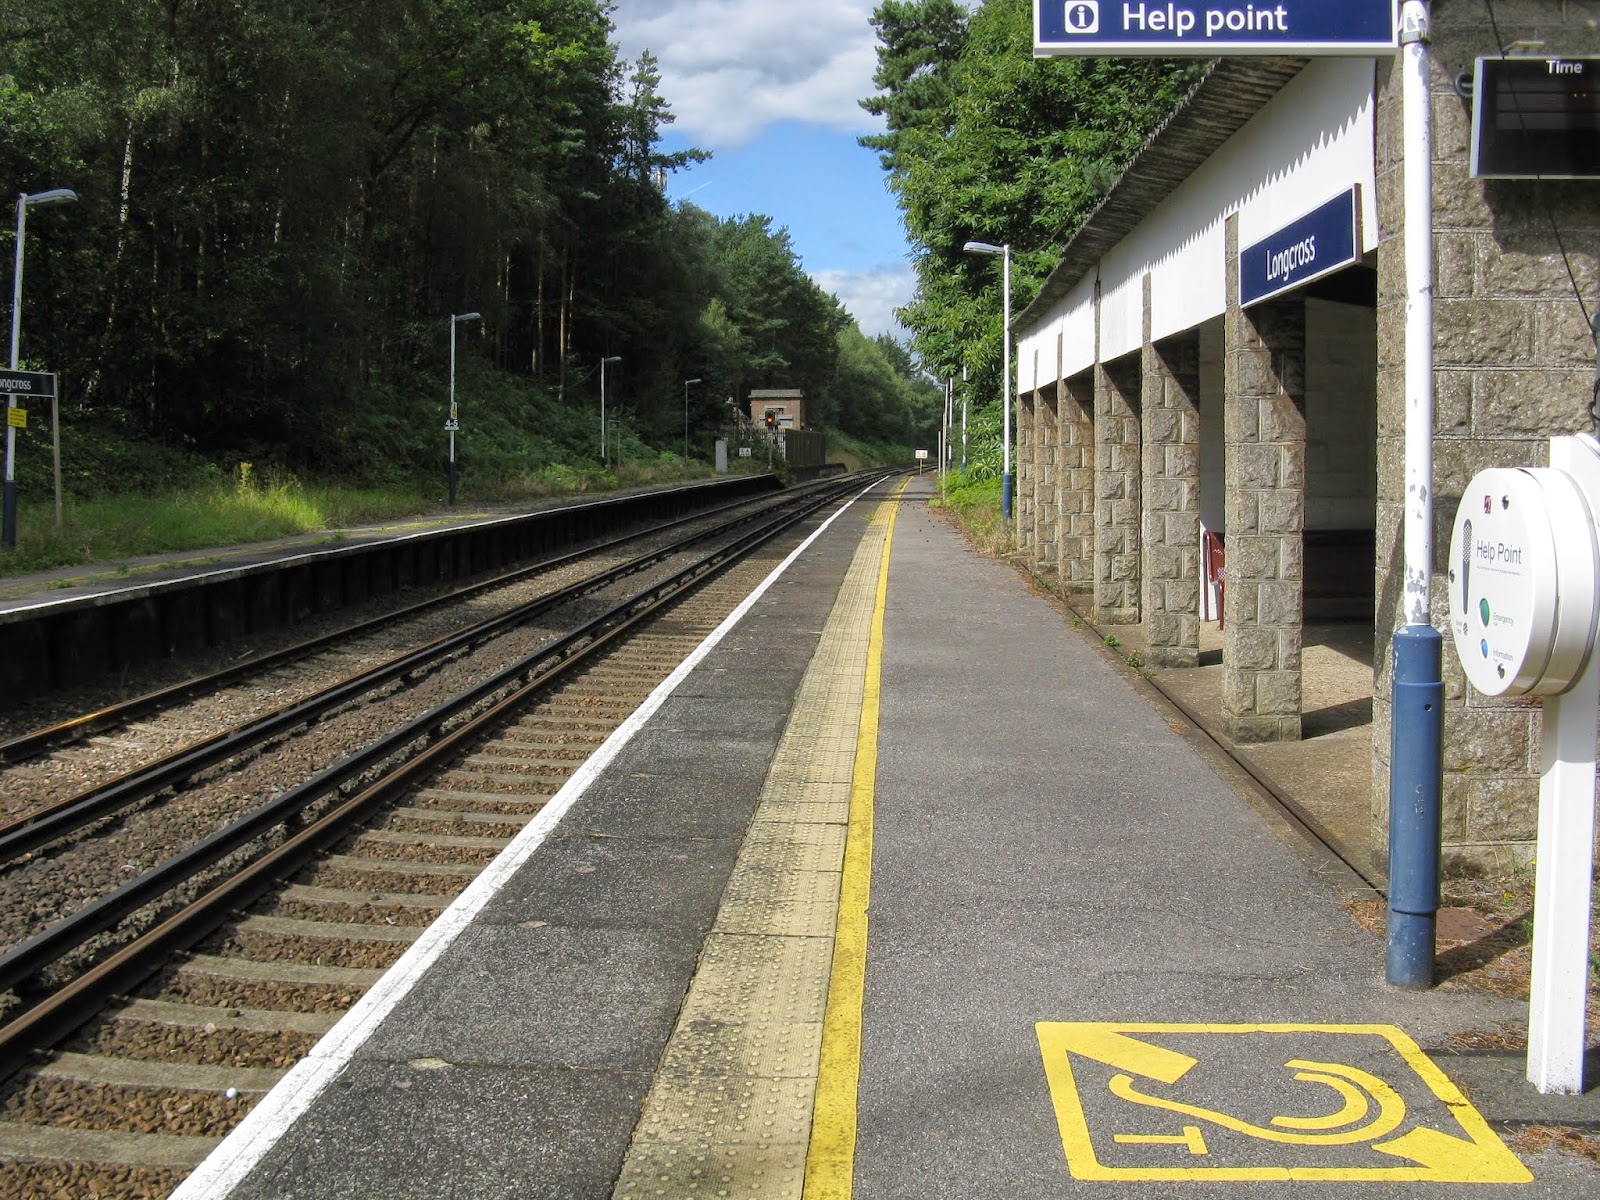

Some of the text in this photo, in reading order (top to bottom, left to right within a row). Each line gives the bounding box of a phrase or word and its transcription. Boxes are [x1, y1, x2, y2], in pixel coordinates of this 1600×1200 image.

[1123, 2, 1196, 37] Help
[1206, 4, 1289, 37] point
[1545, 60, 1583, 74] Time
[1266, 235, 1316, 282] Longcross
[1477, 540, 1521, 564] Help Point
[1493, 612, 1513, 626] Emergency
